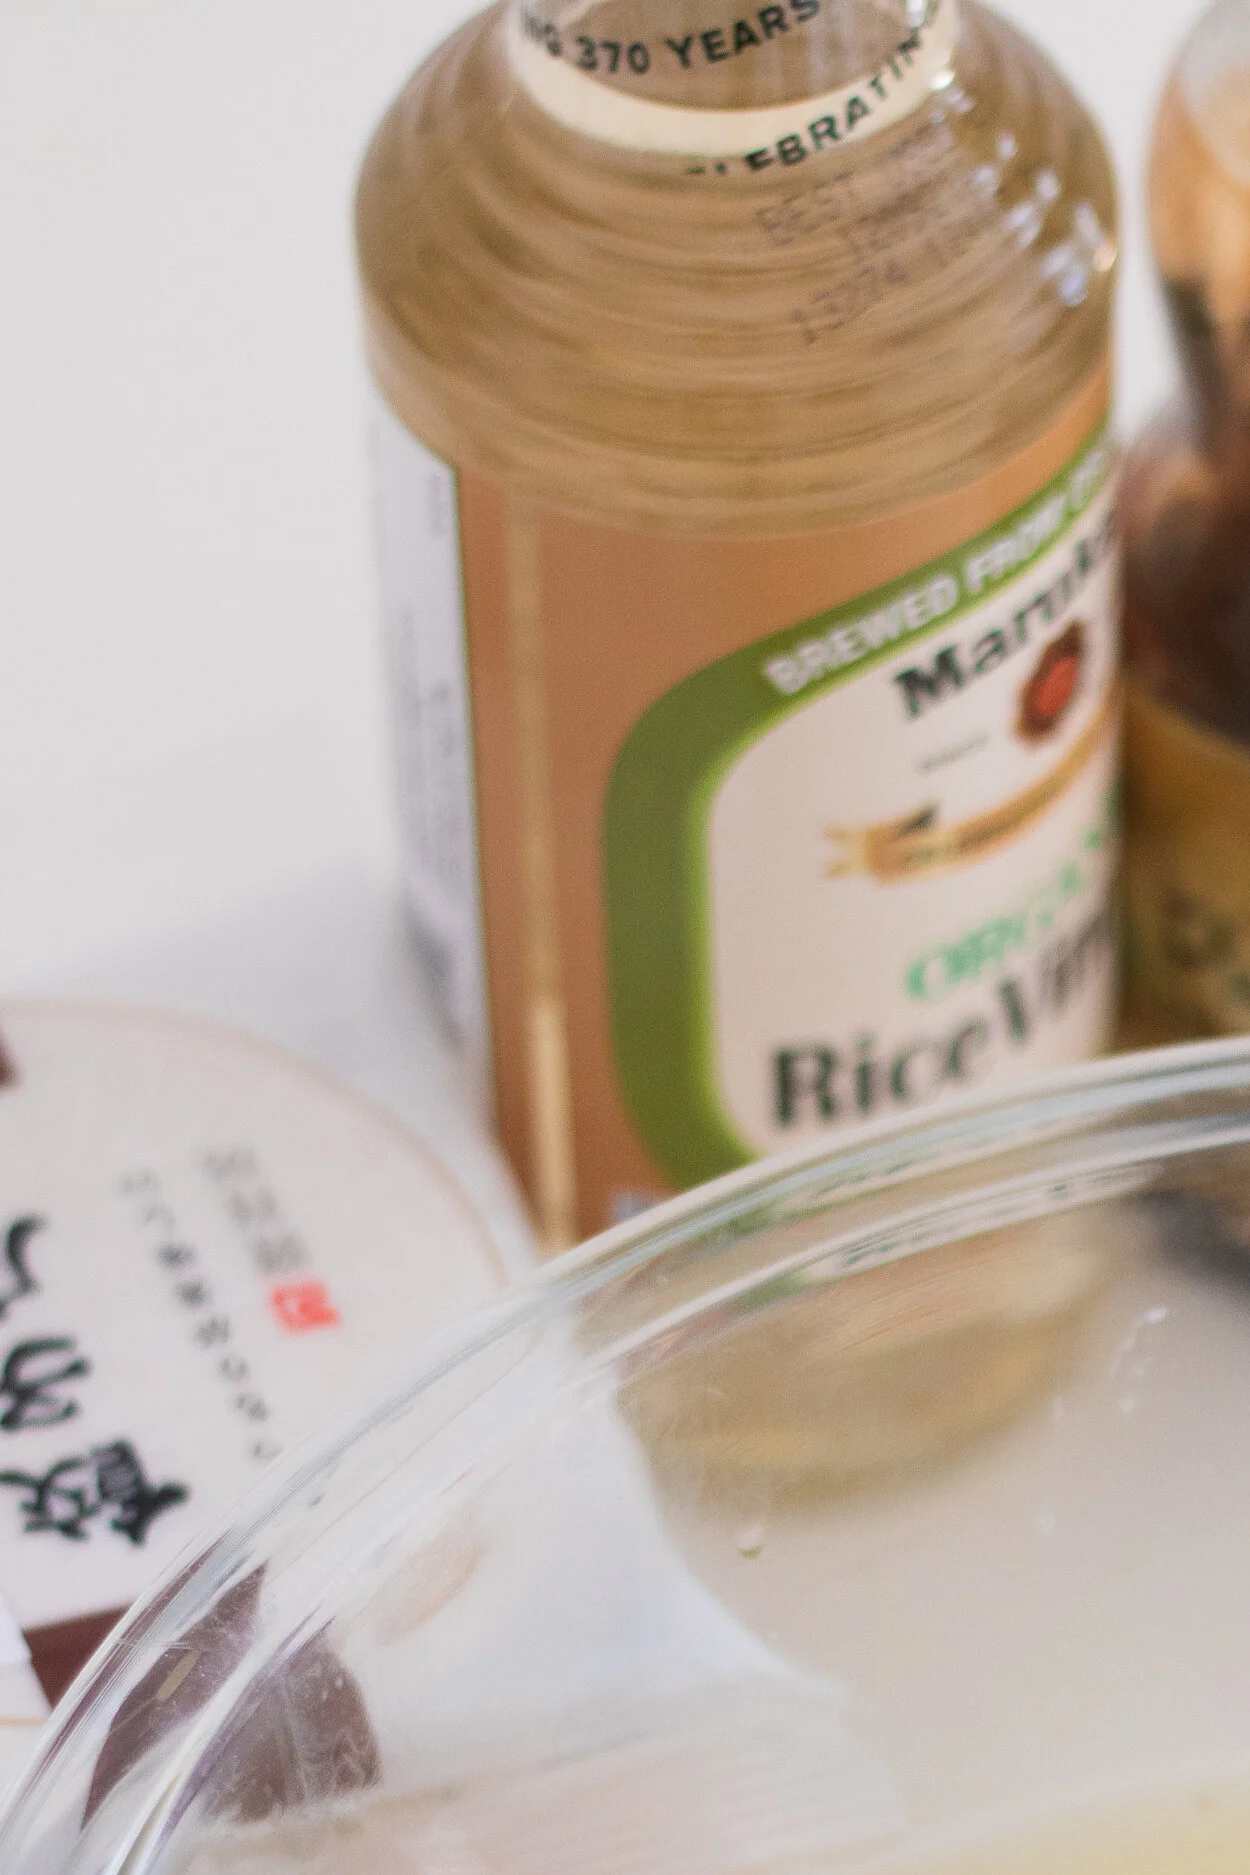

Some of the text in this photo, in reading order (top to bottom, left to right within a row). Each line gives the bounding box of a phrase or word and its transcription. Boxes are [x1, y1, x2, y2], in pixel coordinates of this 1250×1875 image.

[574, 0, 821, 76] 370 YEARS
[763, 574, 958, 695] BREWED
[771, 1014, 988, 1130] Rice
